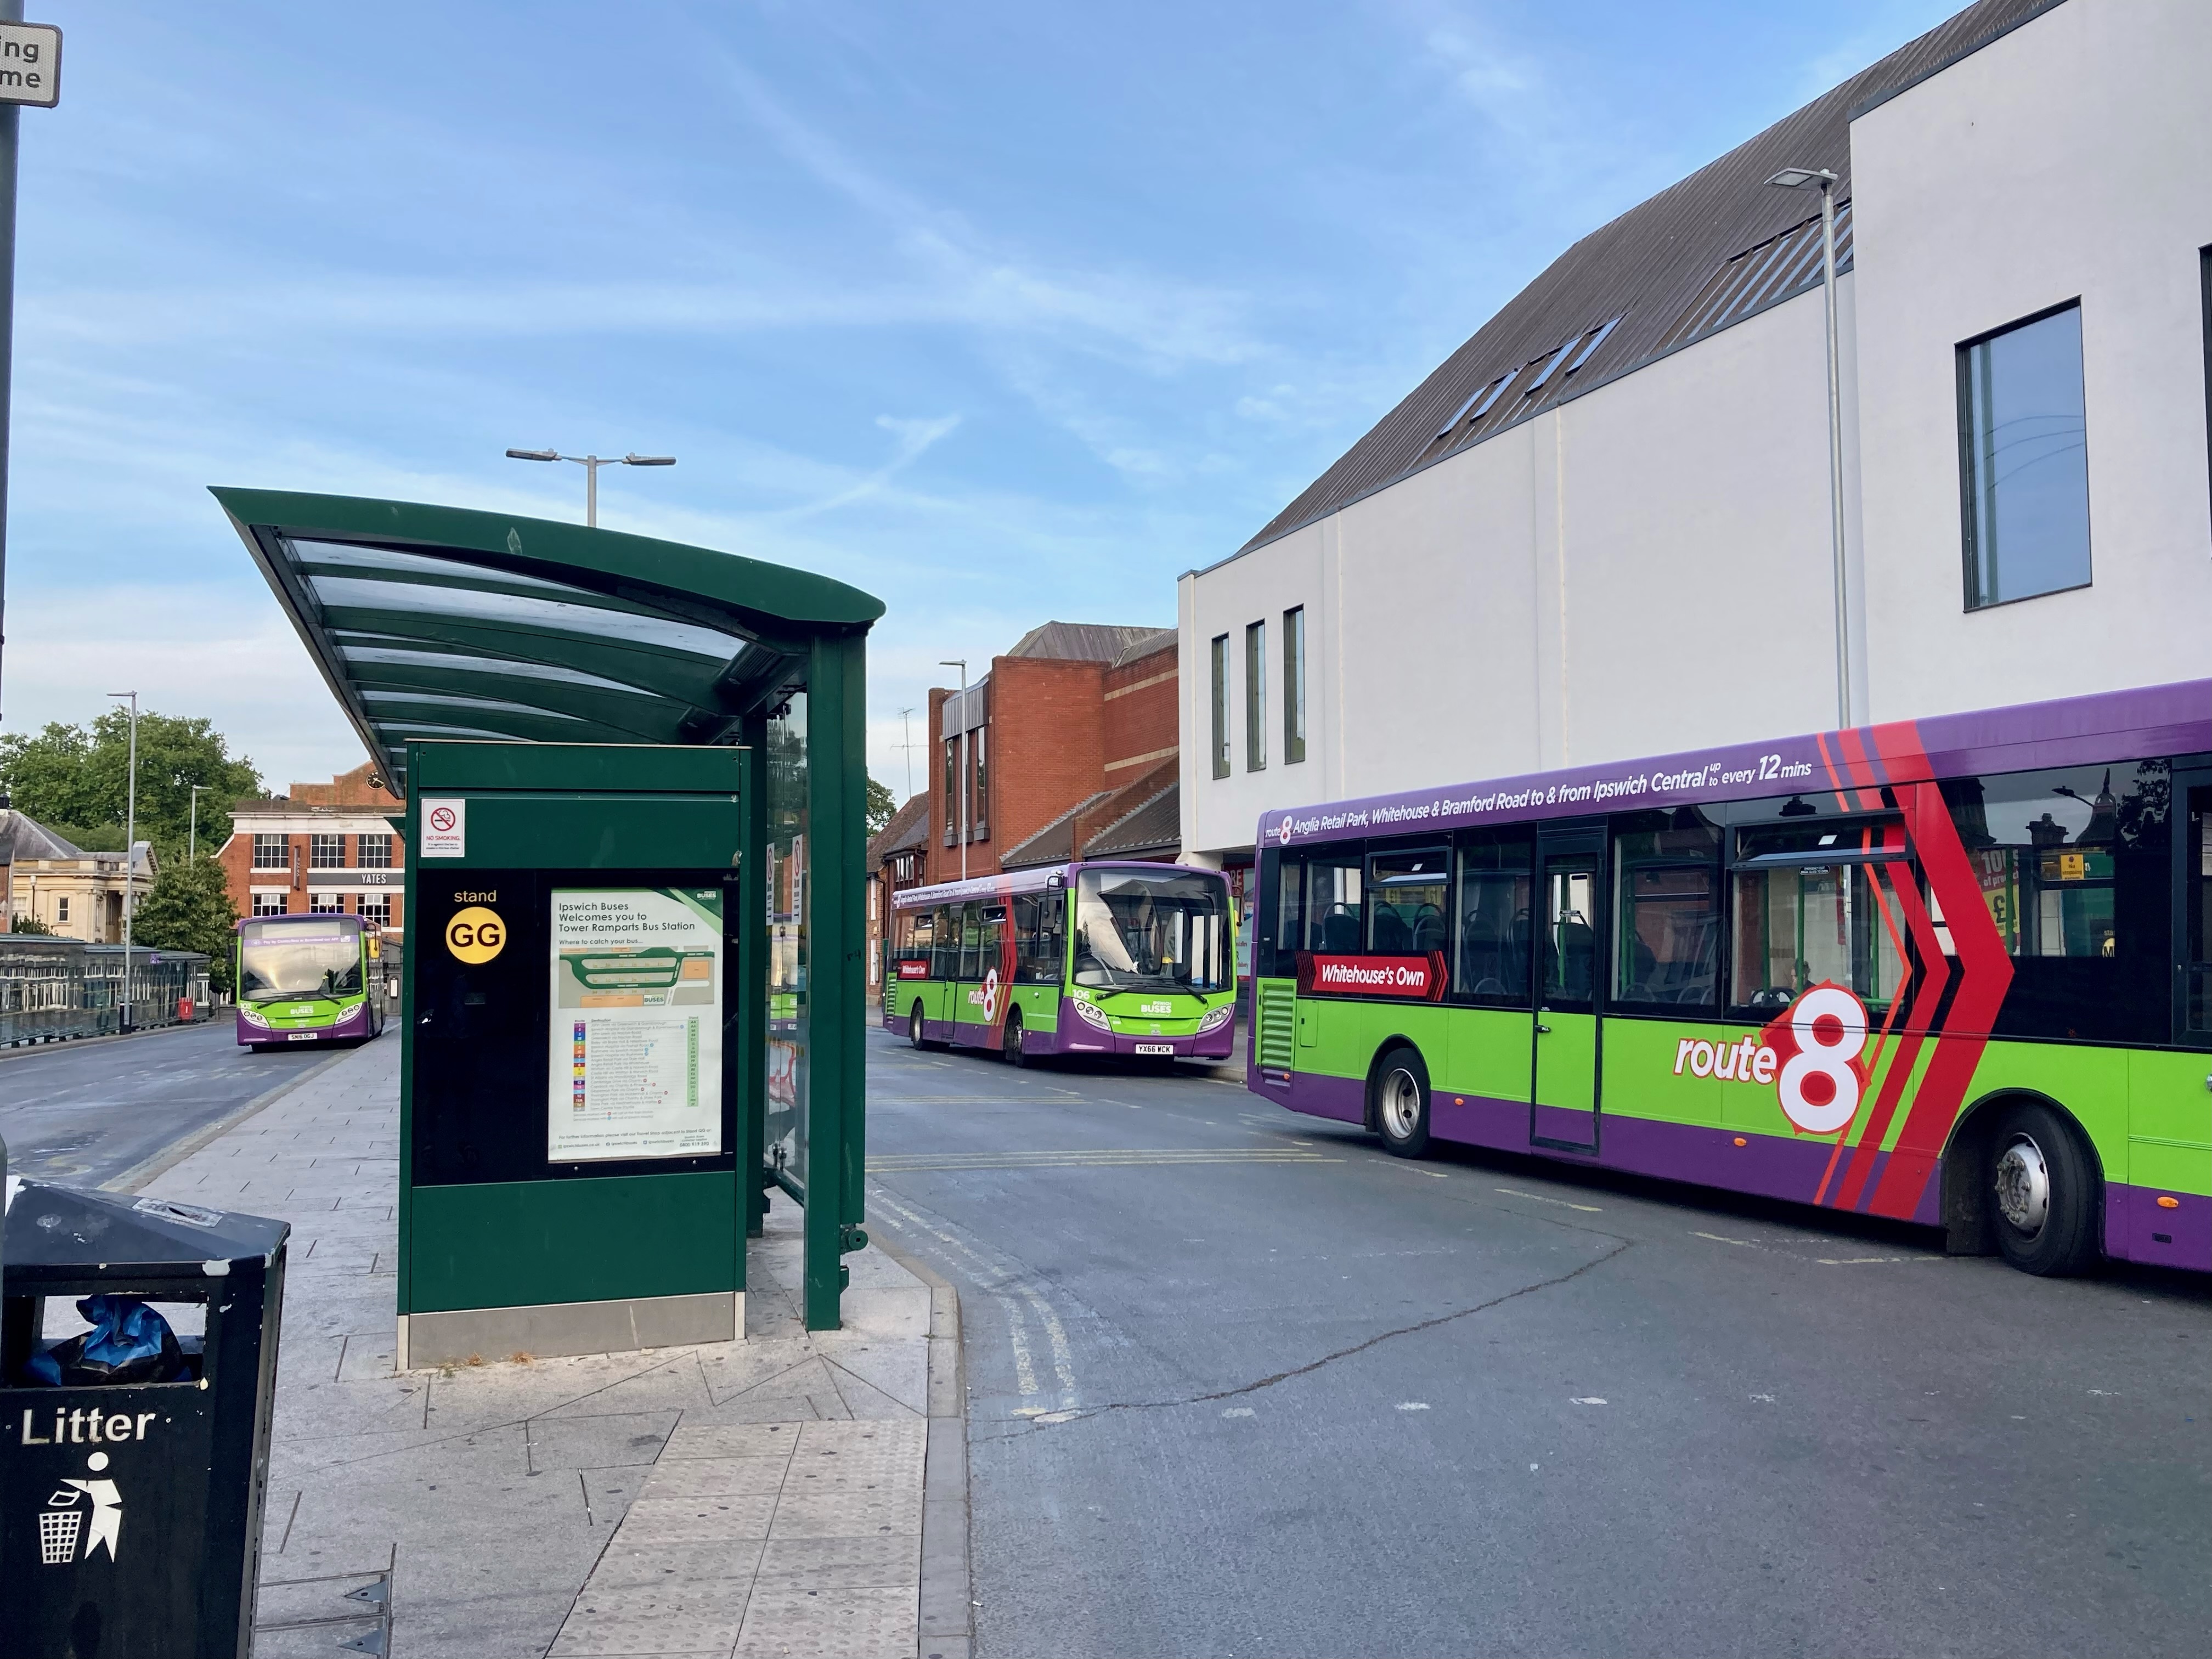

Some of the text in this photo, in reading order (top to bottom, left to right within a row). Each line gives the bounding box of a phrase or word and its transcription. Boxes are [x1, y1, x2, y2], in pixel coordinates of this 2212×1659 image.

[1265, 754, 1812, 844] route 8 Anglia Retail Park, Whitehouse & Bramford Road to & from Ipswich Central up to every 12 mins
[361, 873, 387, 884] YATES
[1228, 870, 1242, 885] RE
[1983, 876, 1991, 887] of
[454, 890, 497, 902] stand
[559, 902, 597, 912] Ipswich
[559, 913, 612, 921] Welcomes
[616, 914, 634, 922] you
[559, 922, 695, 933] Tower Ramparts Bus Station
[450, 923, 500, 947] GG
[1322, 964, 1425, 986] Whitehouse's Own
[968, 969, 997, 1021] route 8
[1073, 989, 1090, 1000] 106
[1141, 1005, 1172, 1013] BUSES
[1674, 986, 1867, 1133] route 8
[21, 1407, 156, 1446] Litter
